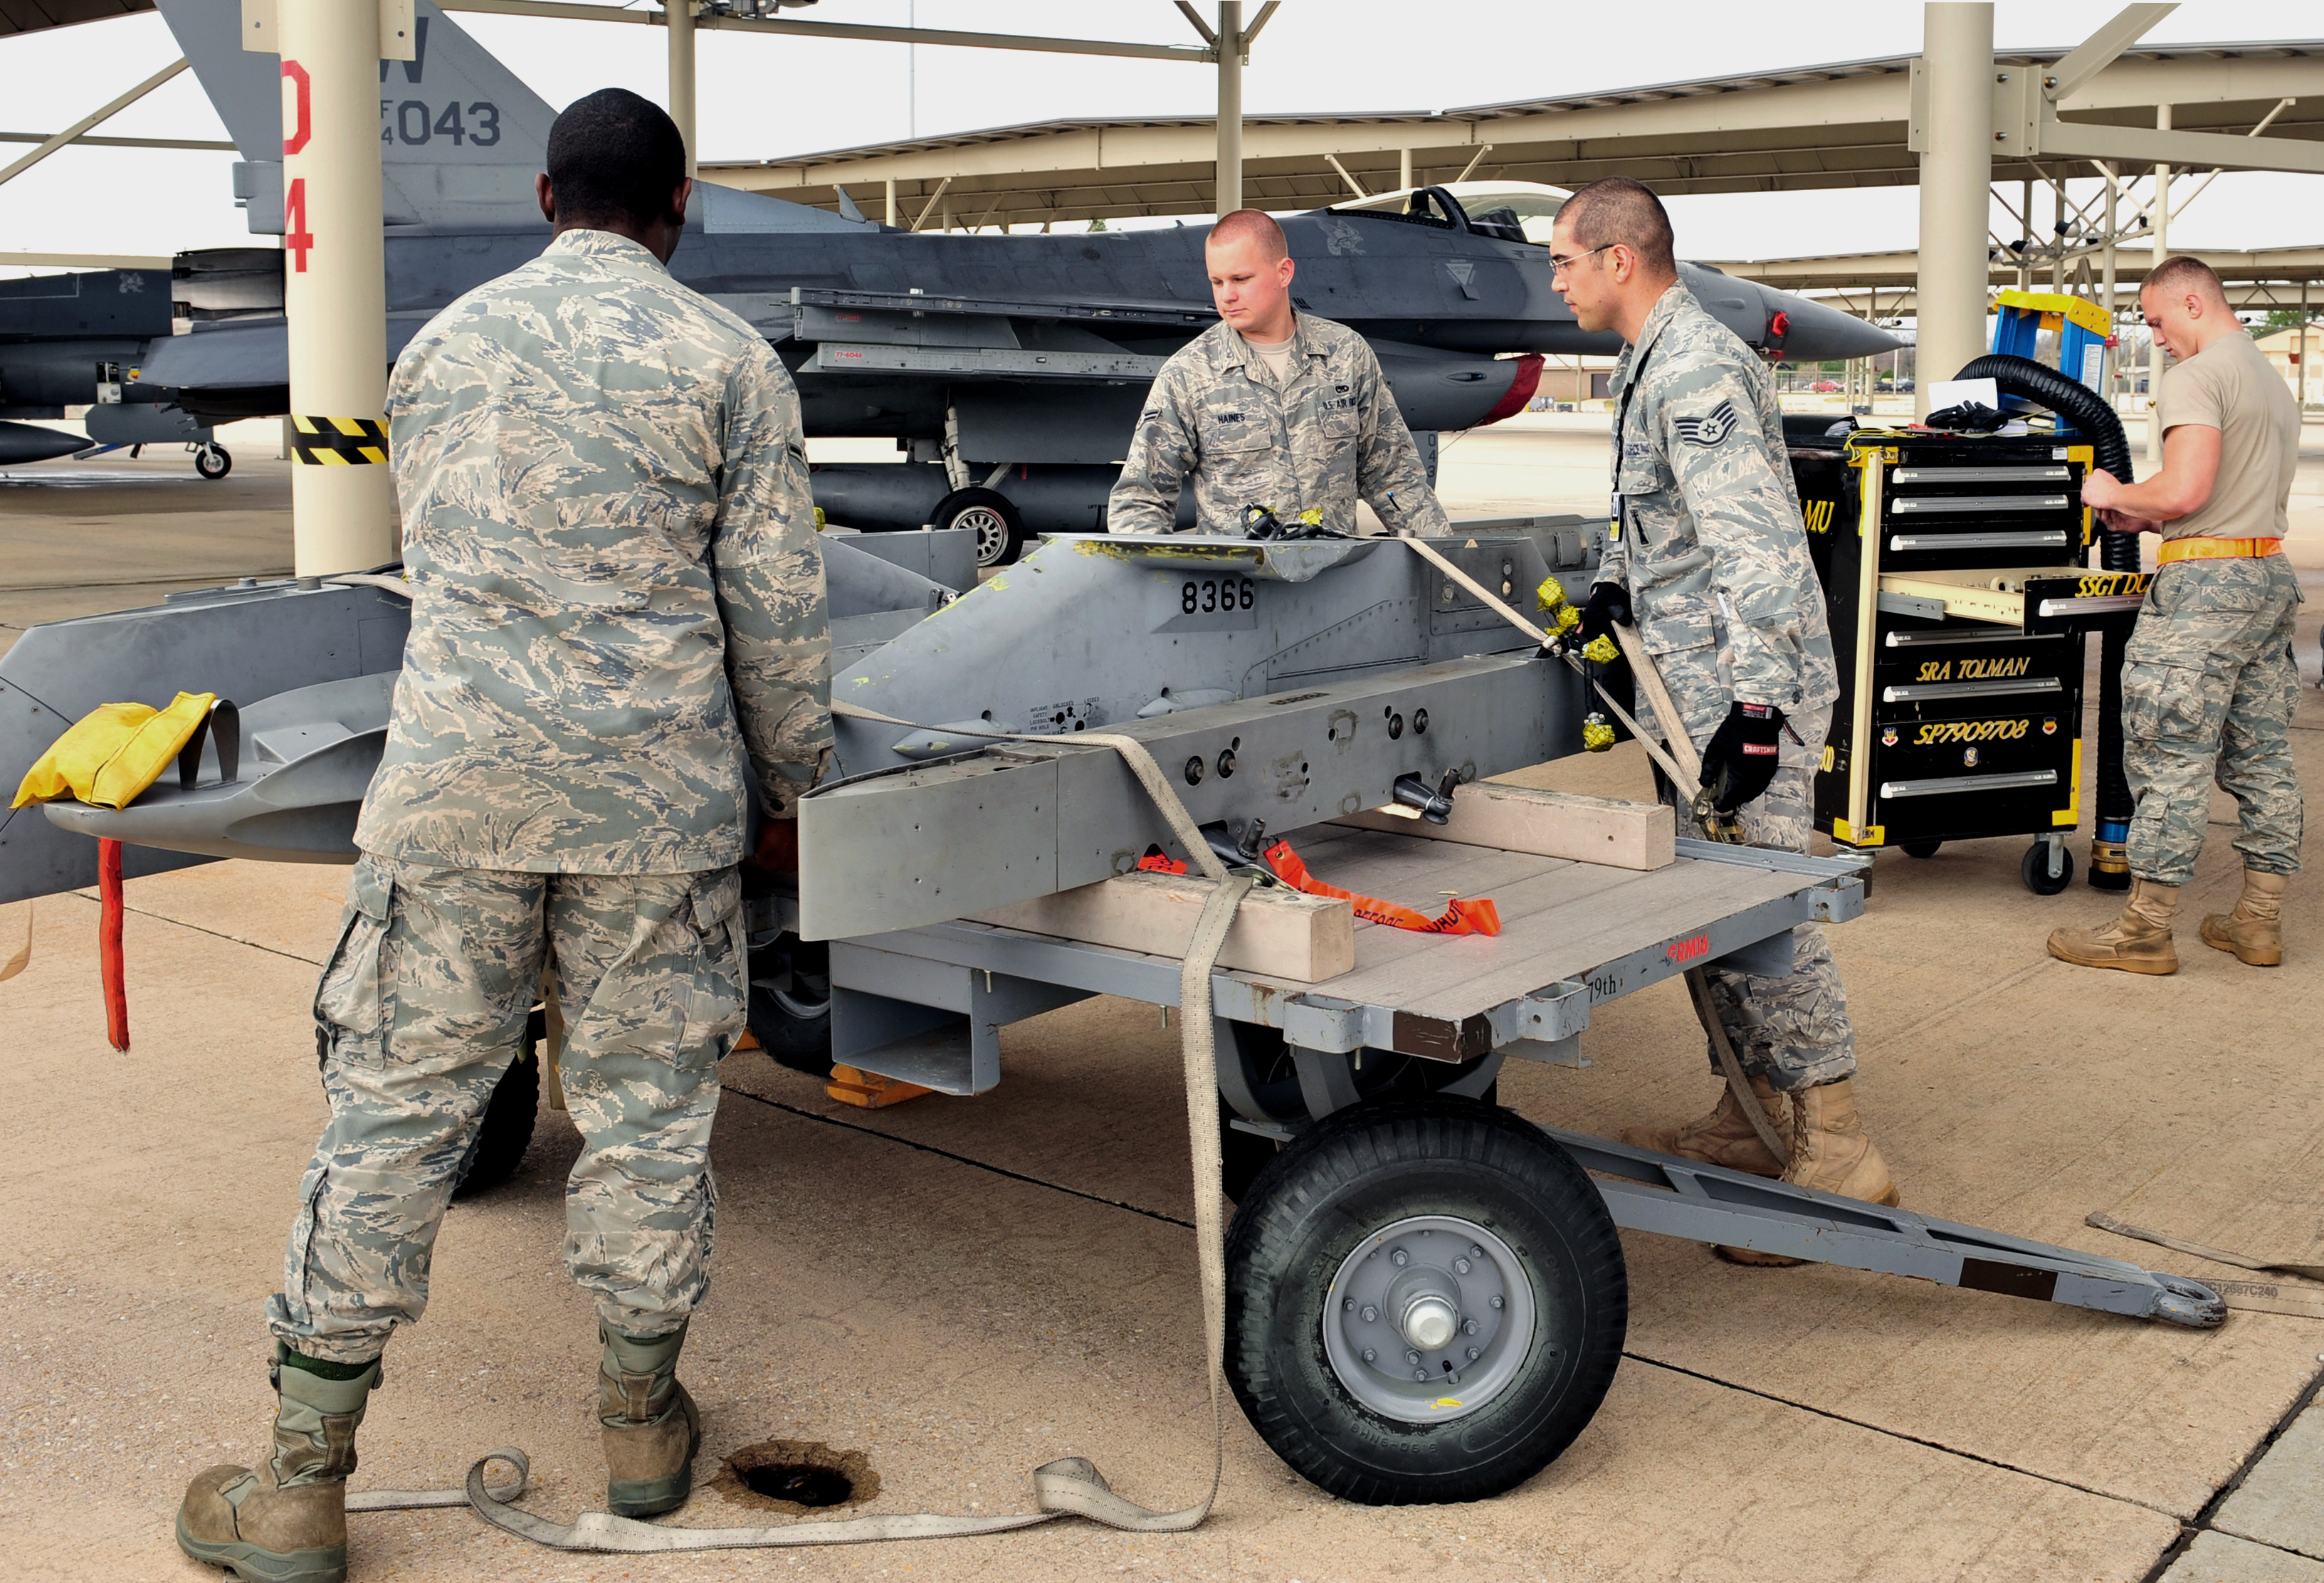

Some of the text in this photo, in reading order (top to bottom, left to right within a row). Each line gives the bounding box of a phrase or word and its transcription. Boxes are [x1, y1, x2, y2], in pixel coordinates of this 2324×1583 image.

[397, 100, 500, 147] 043
[1218, 413, 1245, 424] HAINES
[1798, 498, 1835, 535] MU
[1182, 578, 1253, 614] 8366
[2074, 575, 2123, 598] SSGT
[1916, 656, 2031, 681] SRA TOLMAN
[1913, 719, 2029, 745] SP7909708
[1744, 745, 1777, 754] CRAFTSMAN
[1587, 973, 1616, 1004] 79th
